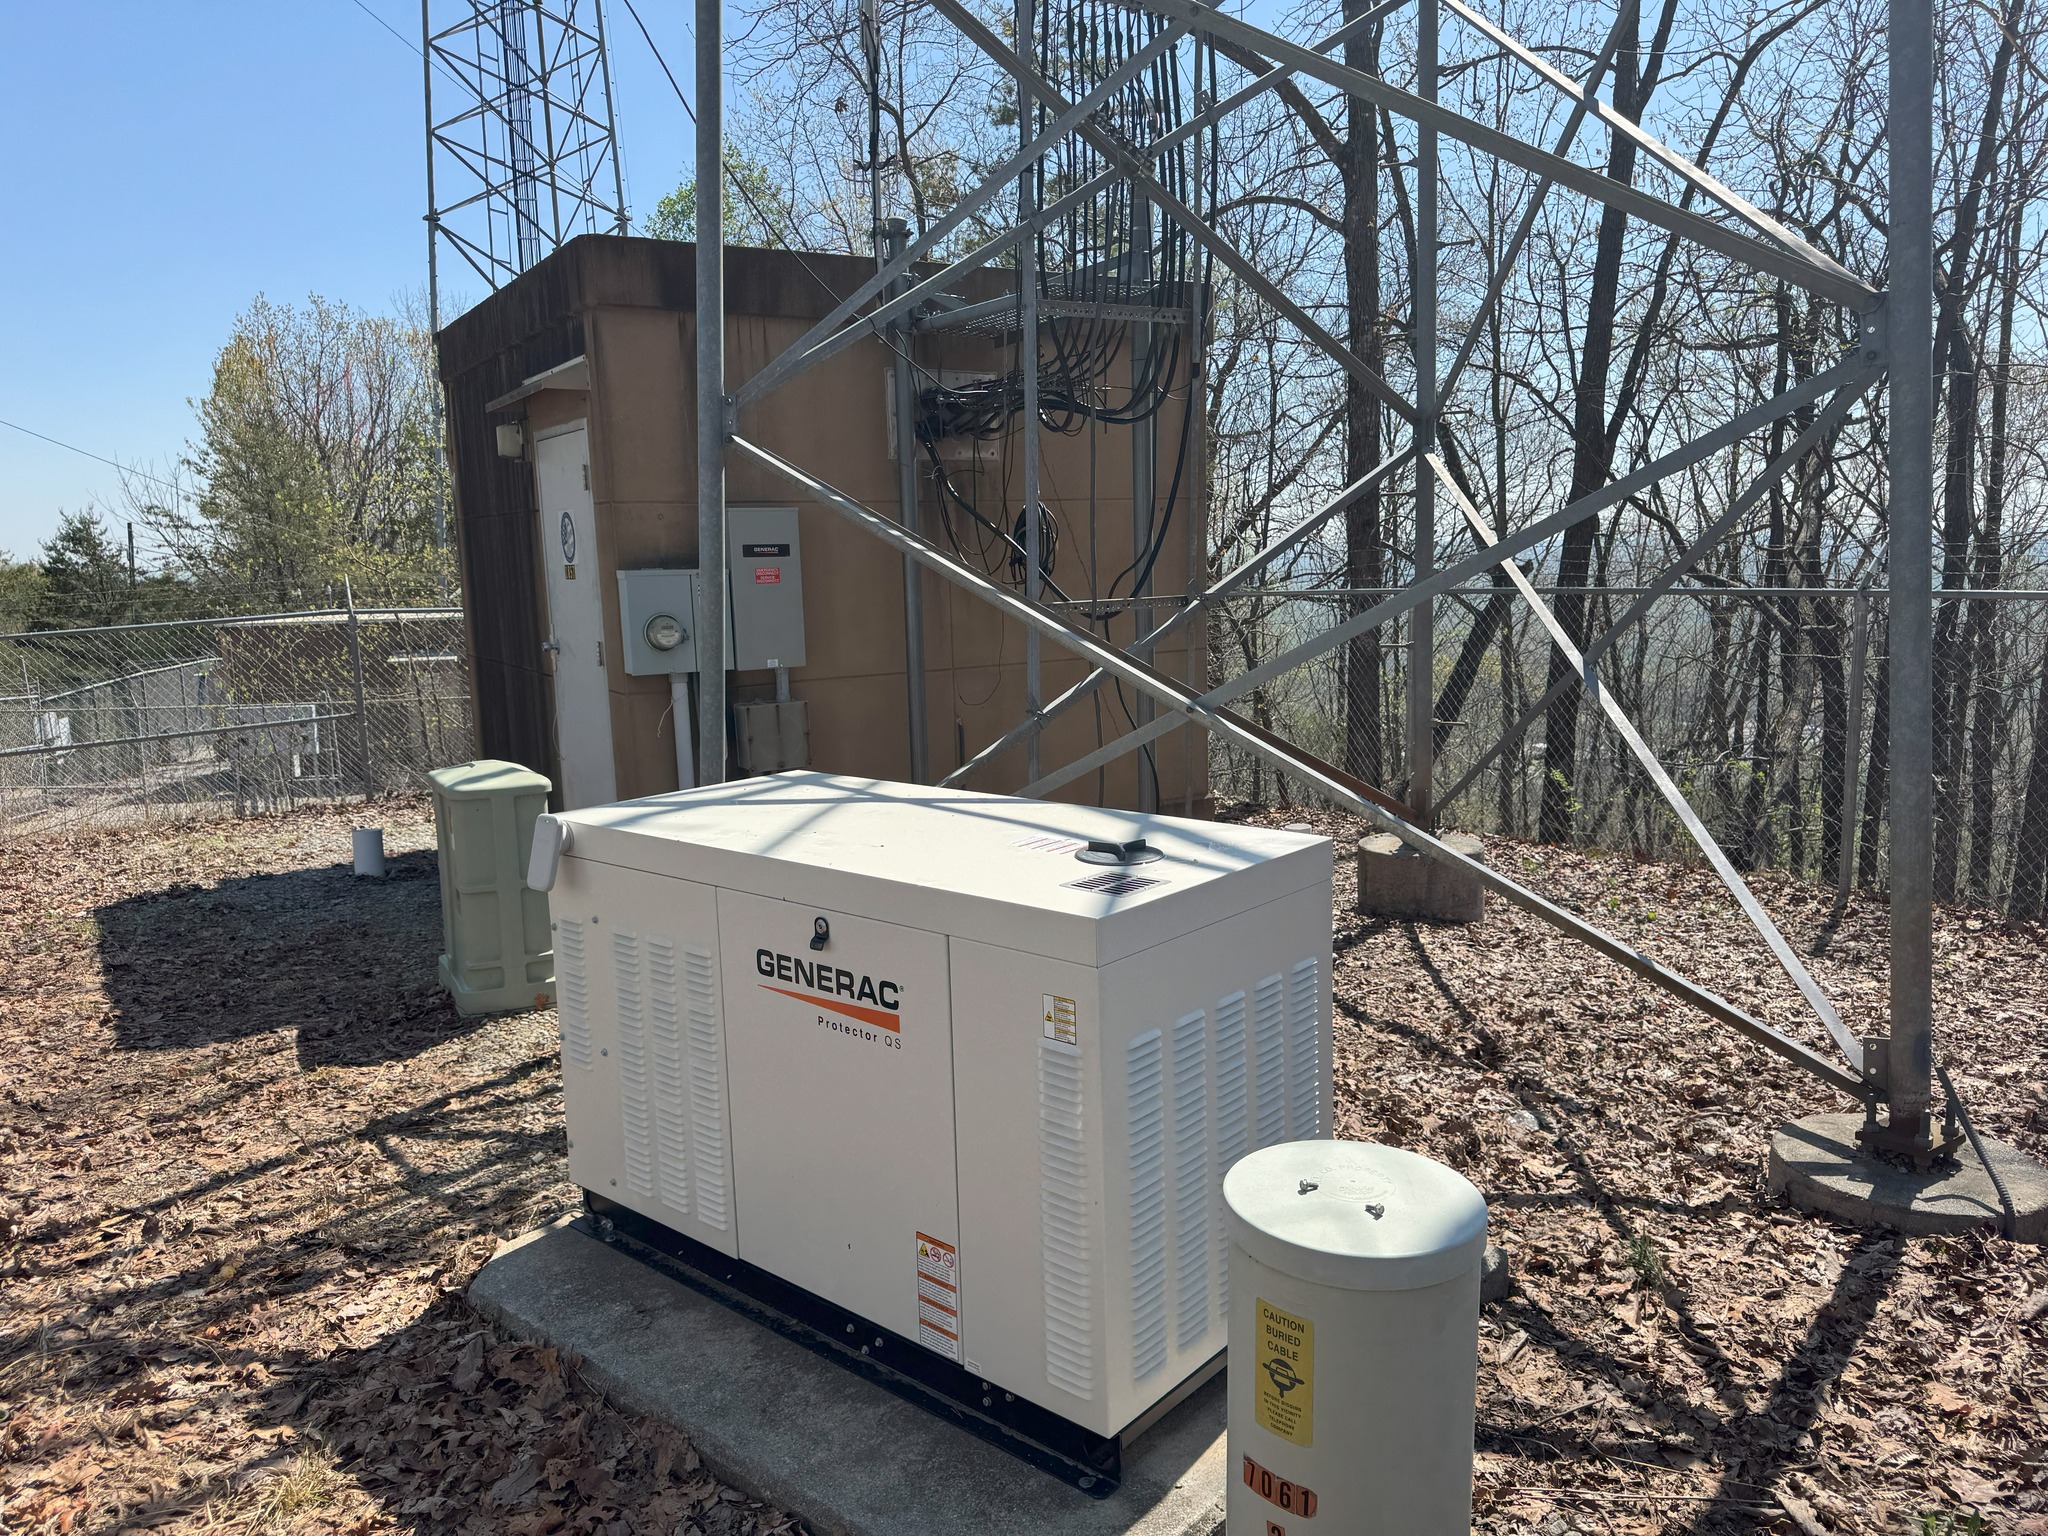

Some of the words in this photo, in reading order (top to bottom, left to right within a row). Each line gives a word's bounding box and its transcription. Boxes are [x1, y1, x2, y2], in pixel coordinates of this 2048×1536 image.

[817, 1015, 878, 1043] Protector
[884, 1035, 902, 1050] QS
[1263, 1308, 1305, 1334] CAUTION
[1266, 1324, 1301, 1347] BURIED
[1267, 1340, 1299, 1362] CABLE
[1263, 1391, 1280, 1404] BEFORE
[1281, 1400, 1302, 1412] DIGGING
[1269, 1401, 1280, 1410] THIS
[1280, 1407, 1301, 1419] VICINITY
[1267, 1407, 1284, 1419] PLEASE
[1284, 1416, 1297, 1425] CALL
[1268, 1414, 1295, 1431] TELEPHONE
[1270, 1422, 1293, 1436] COMPANY
[1247, 1460, 1310, 1517] 7061
